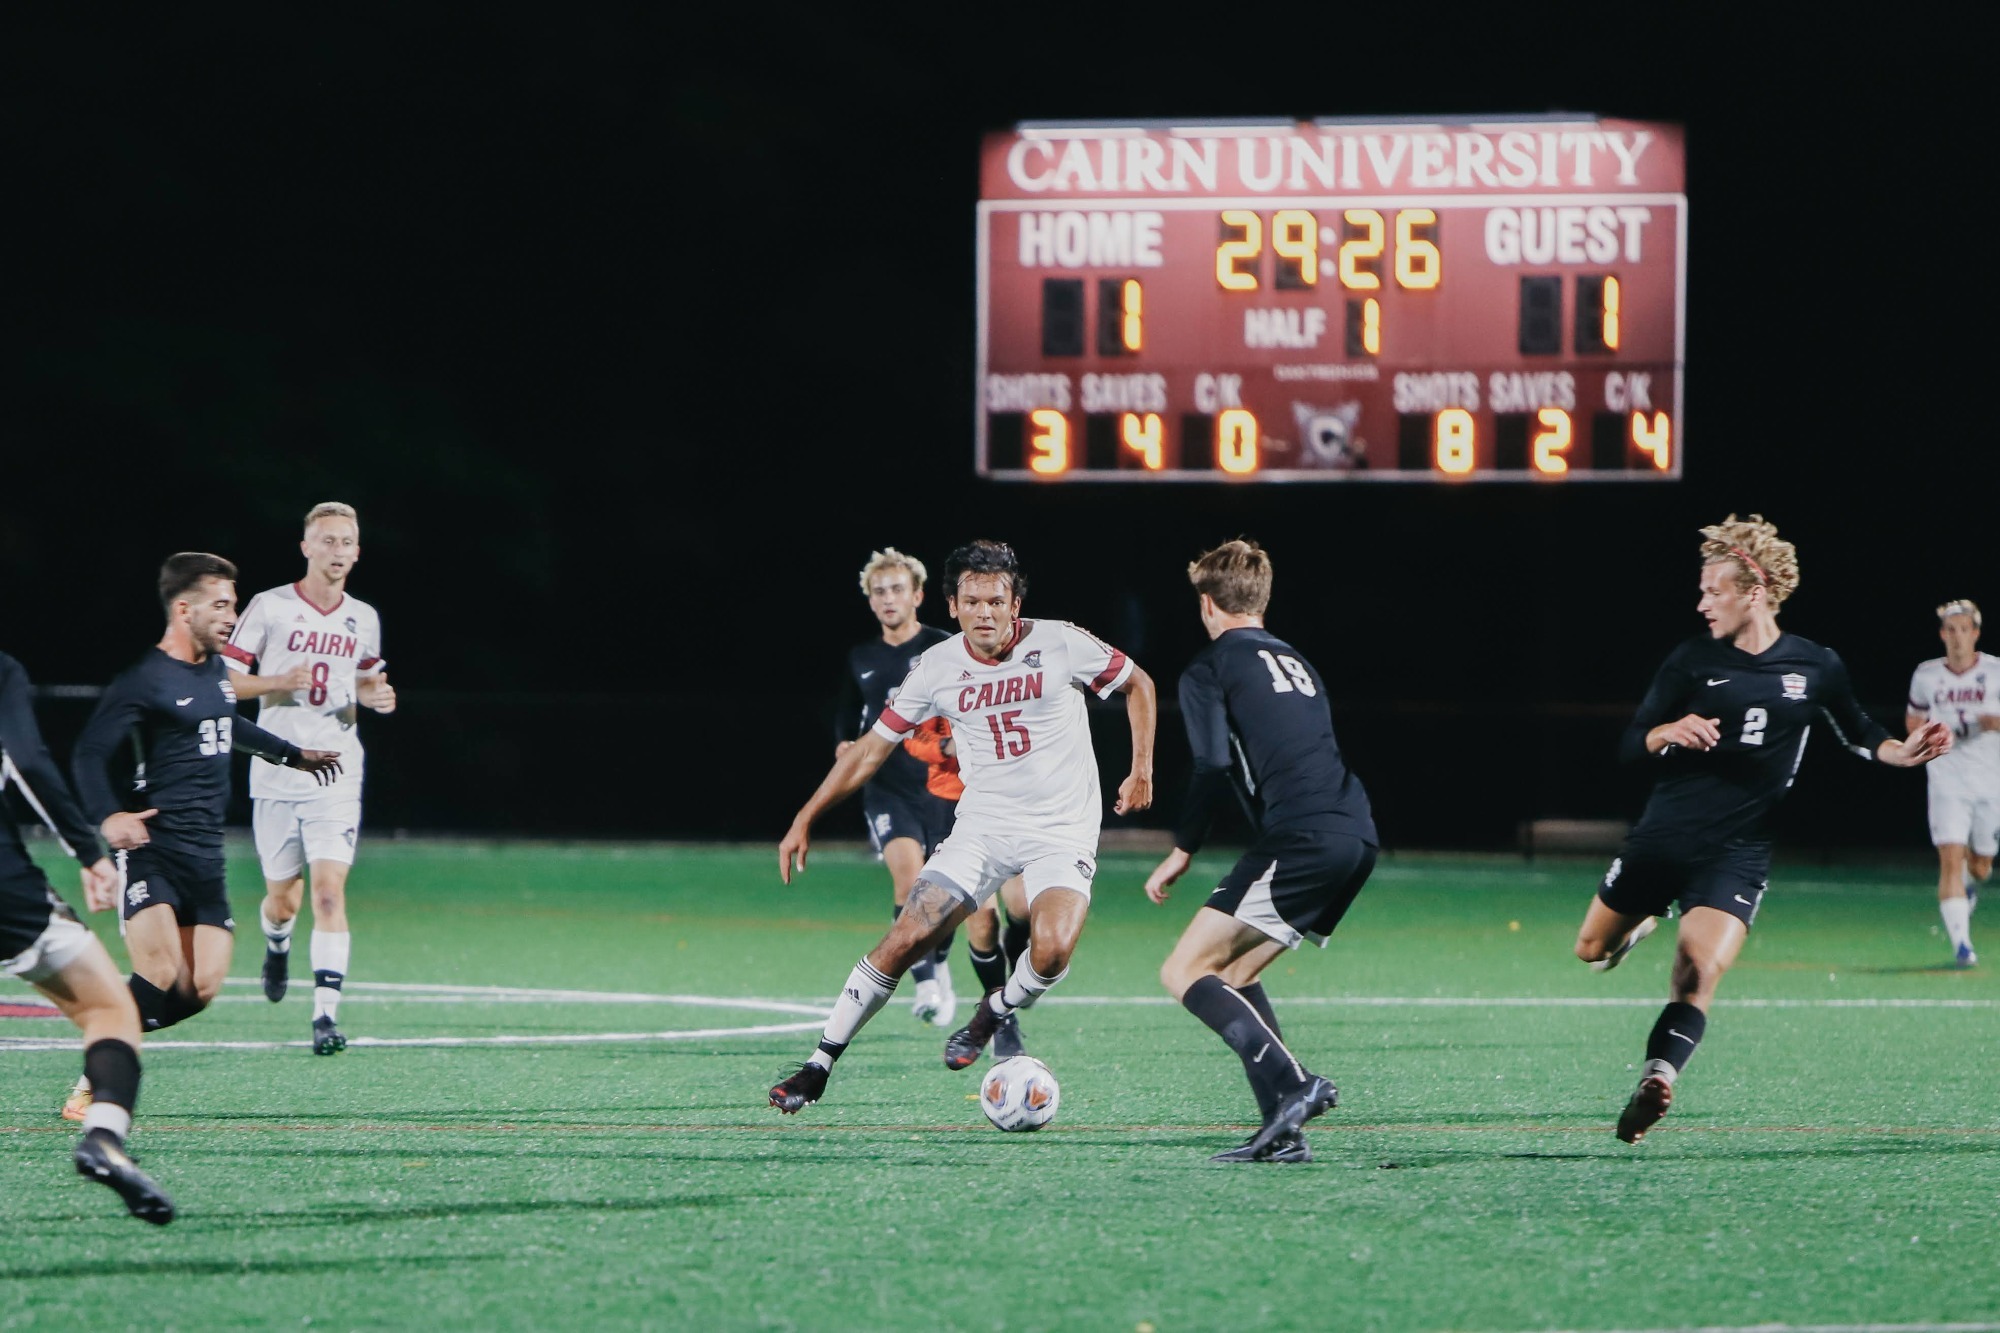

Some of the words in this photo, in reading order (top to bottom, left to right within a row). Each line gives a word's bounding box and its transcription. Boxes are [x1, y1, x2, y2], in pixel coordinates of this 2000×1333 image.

[1007, 138, 1217, 192] CAIRN
[1239, 130, 1651, 192] UNIVERSITY
[1018, 211, 1164, 268] HOME
[1216, 208, 1441, 291] 29:26
[1485, 206, 1651, 264] GUEST
[1123, 279, 1143, 351] 1
[1244, 307, 1326, 349] HALF
[1363, 297, 1381, 354] 1
[1602, 275, 1620, 349] 1
[1393, 372, 1480, 413] SHOTS
[1489, 371, 1576, 412] SAVES
[1030, 409, 1069, 474] 3
[1122, 412, 1163, 471] 4
[1217, 409, 1258, 474] 0
[1436, 408, 1475, 474] 8
[1533, 408, 1572, 474] 2
[1632, 411, 1670, 471] 4
[287, 630, 357, 659] CAIRN
[309, 662, 329, 706] 8
[958, 672, 1043, 713] CAIRN
[1257, 649, 1317, 698] 19
[198, 717, 233, 755] 33
[985, 709, 1031, 760] 15
[1739, 707, 1769, 745] 2
